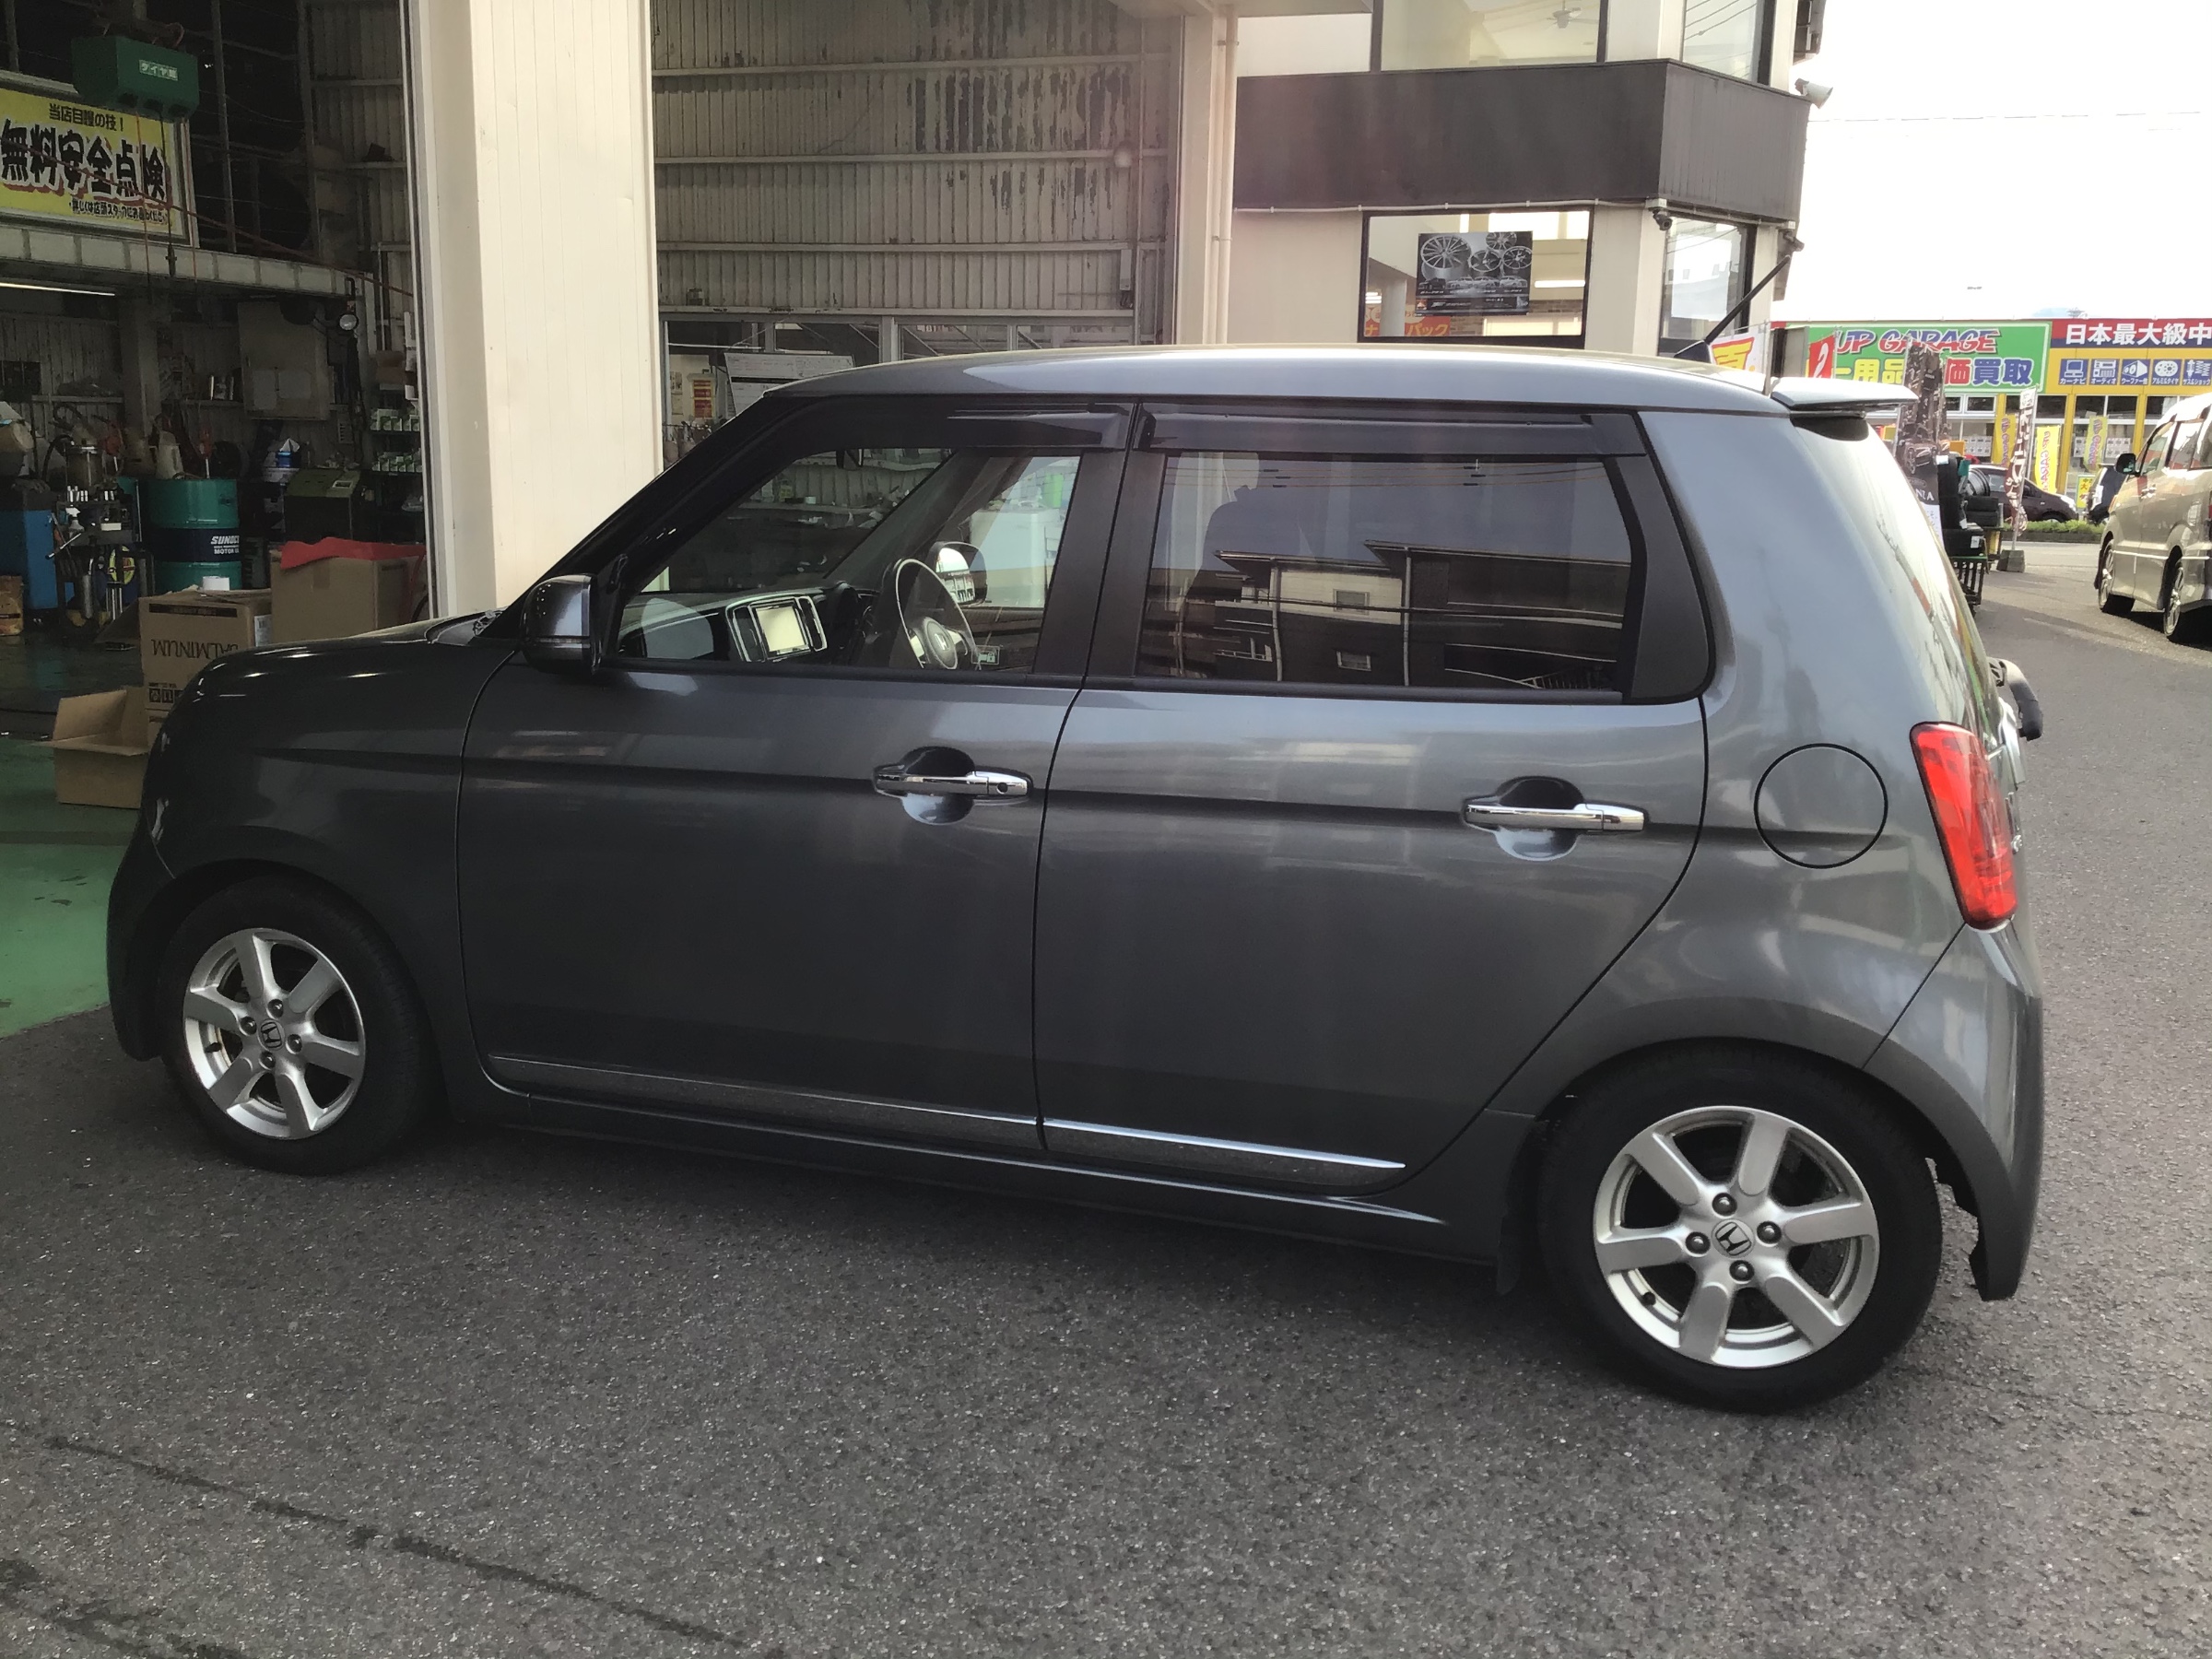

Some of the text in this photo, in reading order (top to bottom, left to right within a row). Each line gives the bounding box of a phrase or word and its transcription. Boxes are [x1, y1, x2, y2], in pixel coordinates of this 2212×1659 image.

[1, 118, 165, 200] 無料安全点検
[1835, 328, 2001, 354] UP GARAGE
[2065, 322, 2212, 346] 日本最大級中
